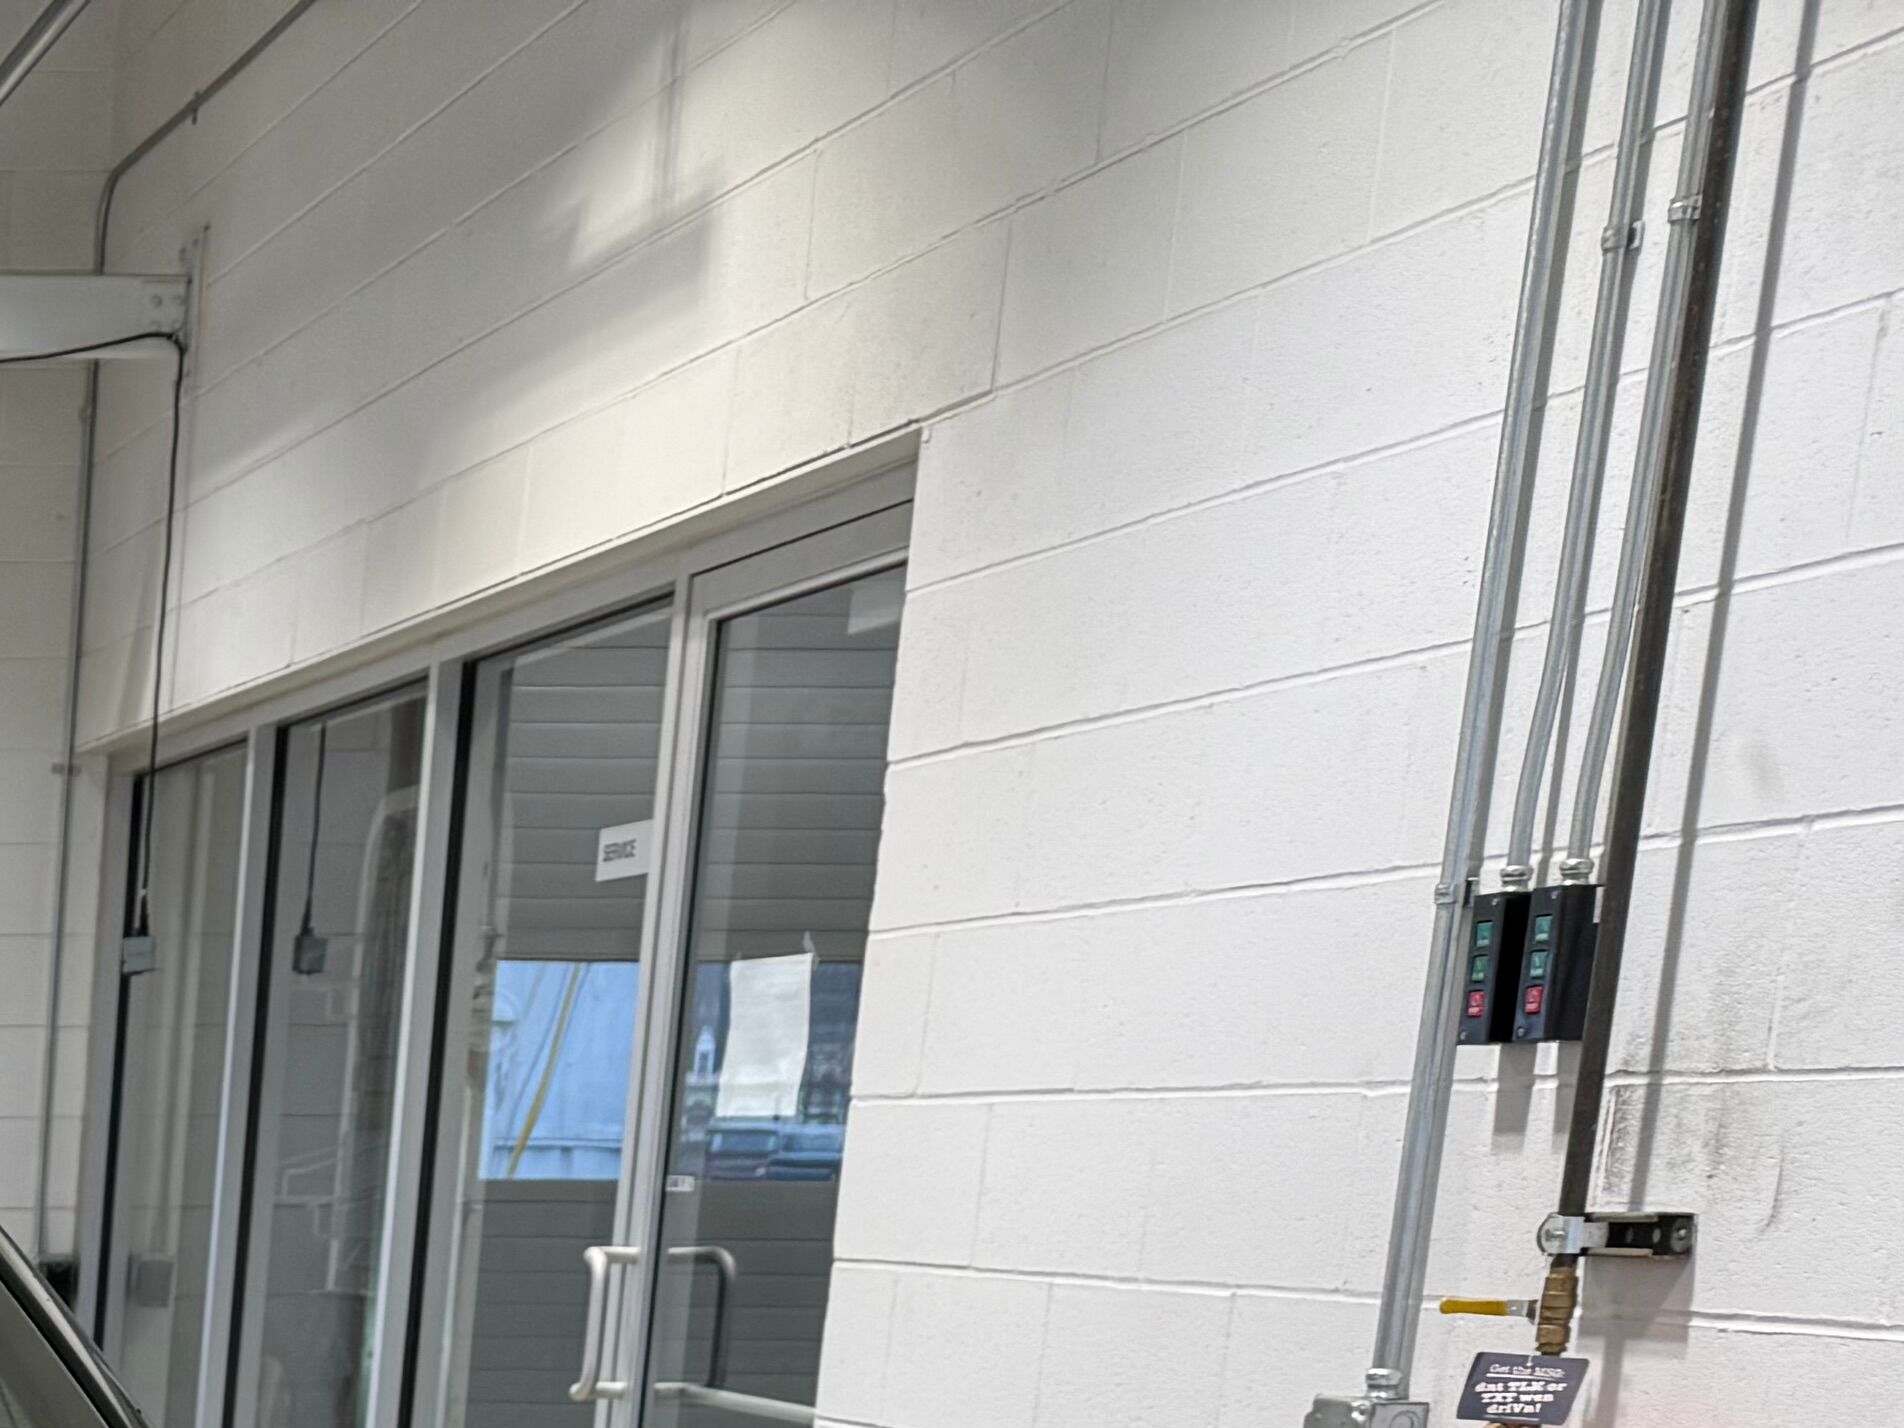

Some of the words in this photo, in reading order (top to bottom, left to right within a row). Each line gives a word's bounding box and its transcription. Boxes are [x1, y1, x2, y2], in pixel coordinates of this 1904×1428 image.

[1507, 1381, 1546, 1392] TLK
[1546, 1382, 1568, 1391] or
[1480, 1392, 1518, 1403] TXT
